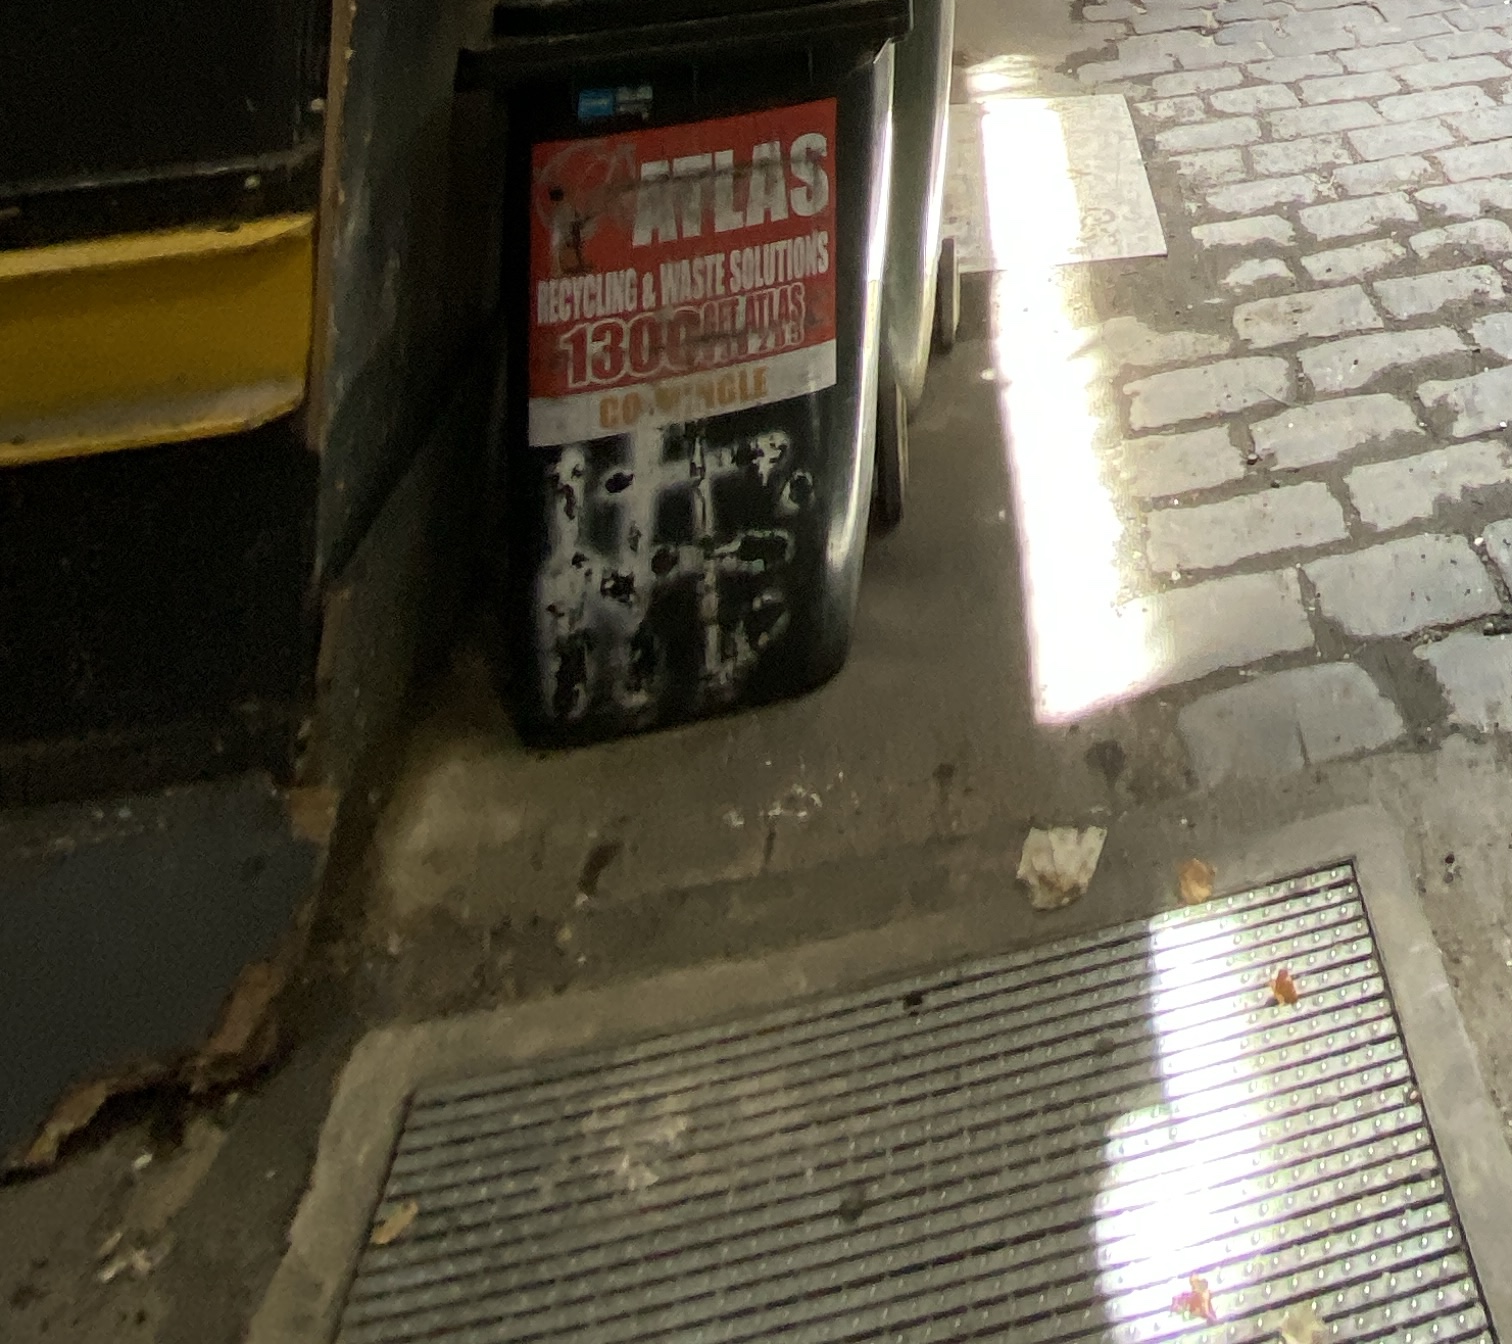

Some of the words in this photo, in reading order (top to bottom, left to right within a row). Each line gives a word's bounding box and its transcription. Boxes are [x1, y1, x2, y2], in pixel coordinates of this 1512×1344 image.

[632, 132, 830, 250] ATLAS
[536, 267, 638, 325] RECYCLING
[642, 271, 656, 311] &
[660, 253, 726, 306] WASTE
[729, 230, 830, 293] SOLUTIONS
